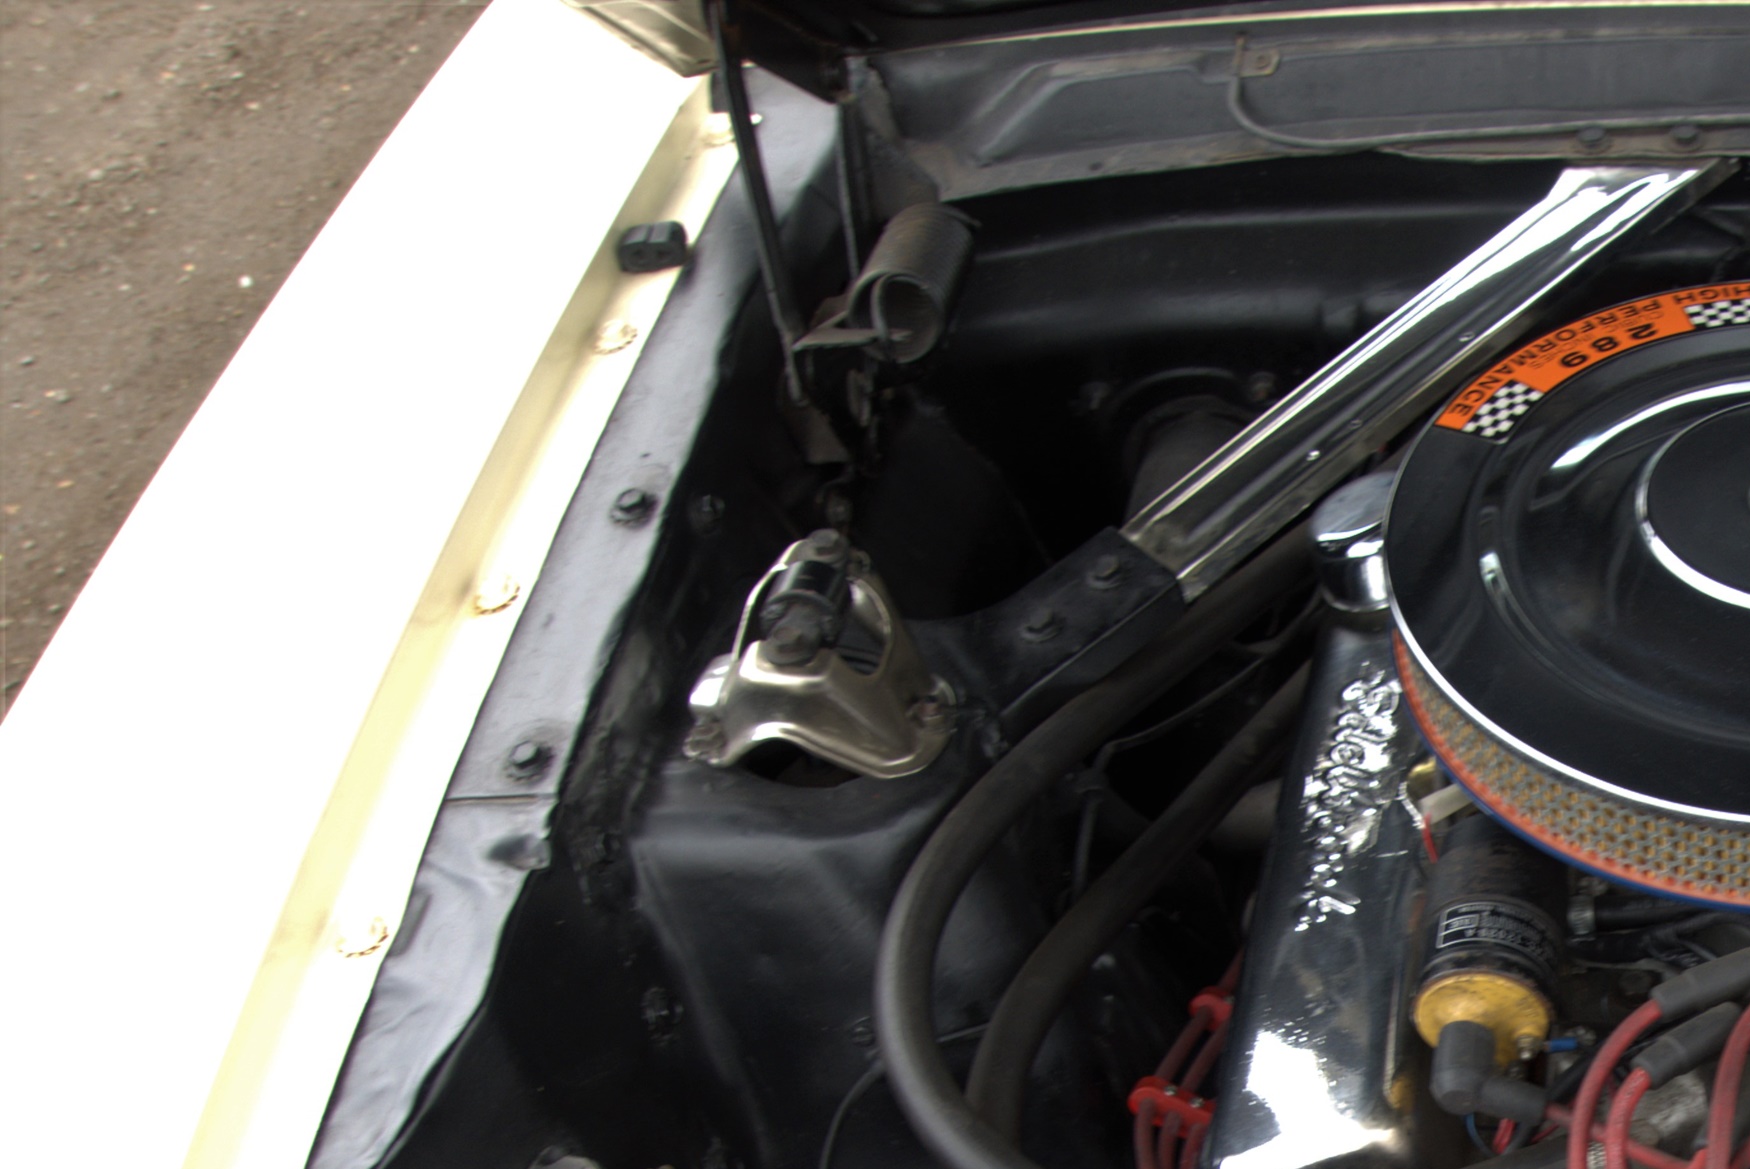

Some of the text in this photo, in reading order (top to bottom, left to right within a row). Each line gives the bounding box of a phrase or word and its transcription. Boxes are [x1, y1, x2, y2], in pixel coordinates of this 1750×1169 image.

[1448, 299, 1663, 417] PERFORMANCE
[1530, 333, 1593, 370] INCHES
[1560, 323, 1658, 369] 289
